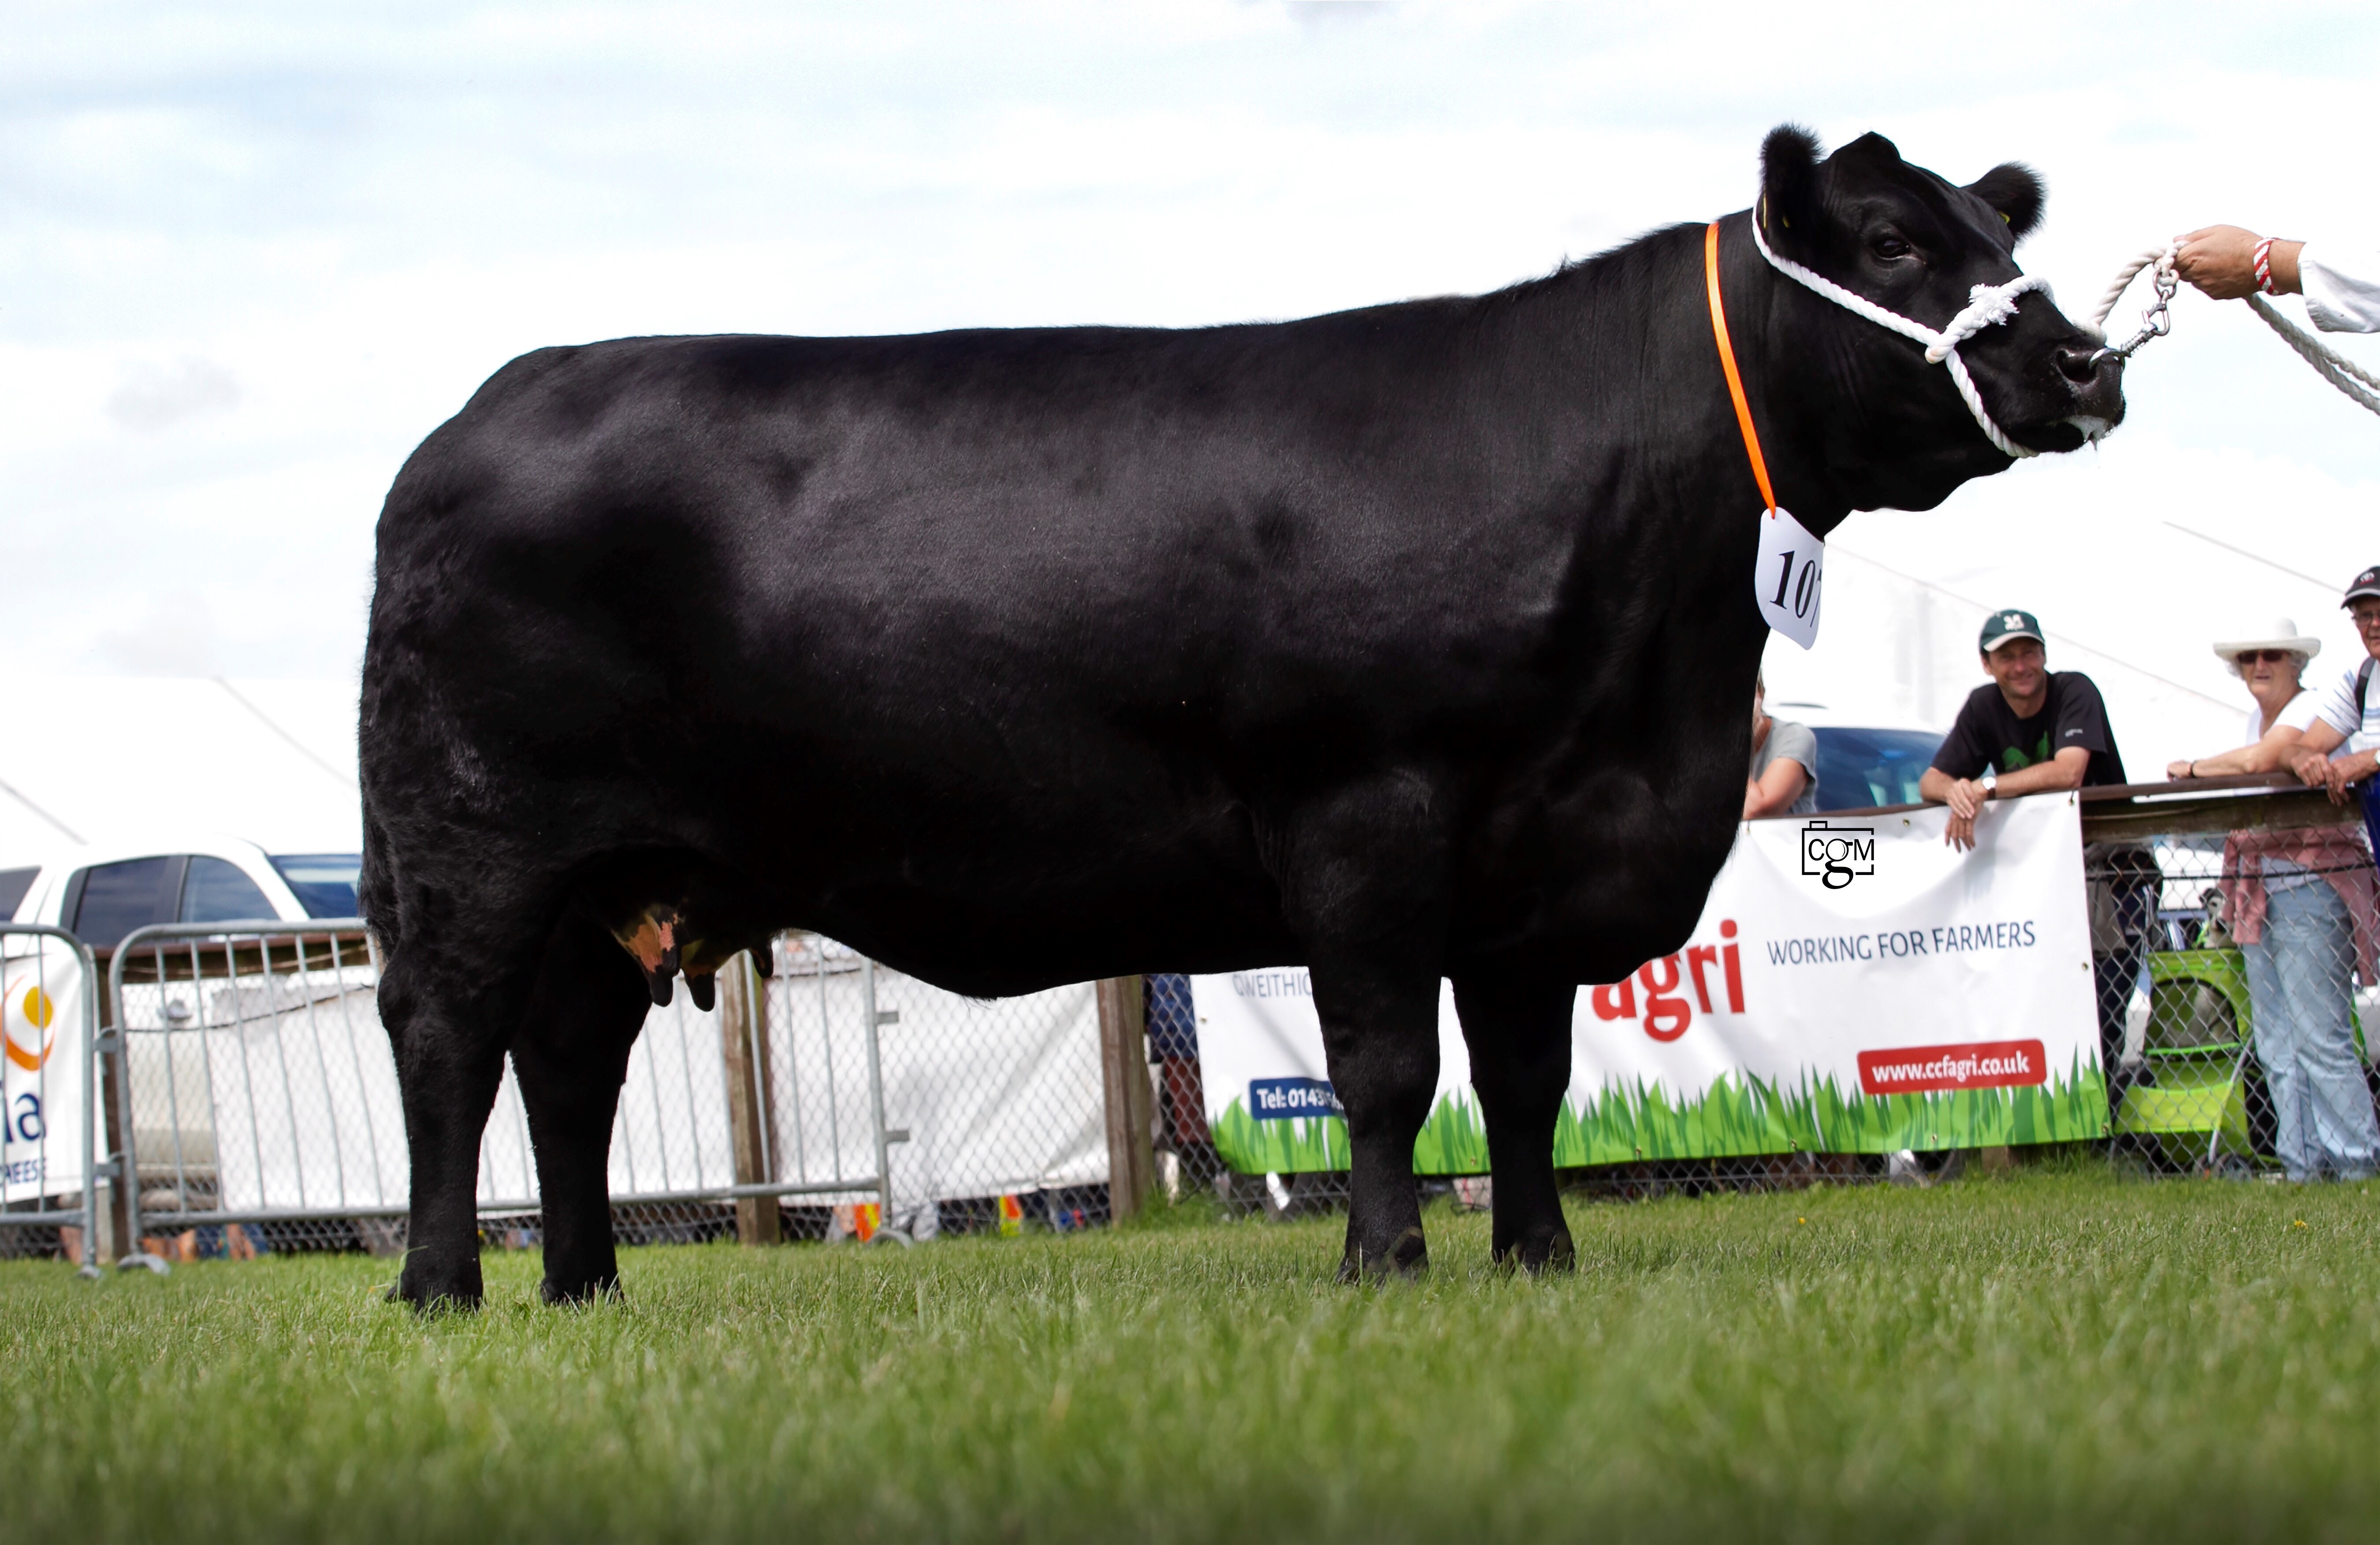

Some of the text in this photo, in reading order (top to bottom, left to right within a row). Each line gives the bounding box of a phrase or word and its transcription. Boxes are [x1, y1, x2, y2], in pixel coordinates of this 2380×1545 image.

[1766, 920, 2036, 966] WORKING FOR FARMERS
[1871, 1050, 2030, 1083] www.ccfagri.co.uk
